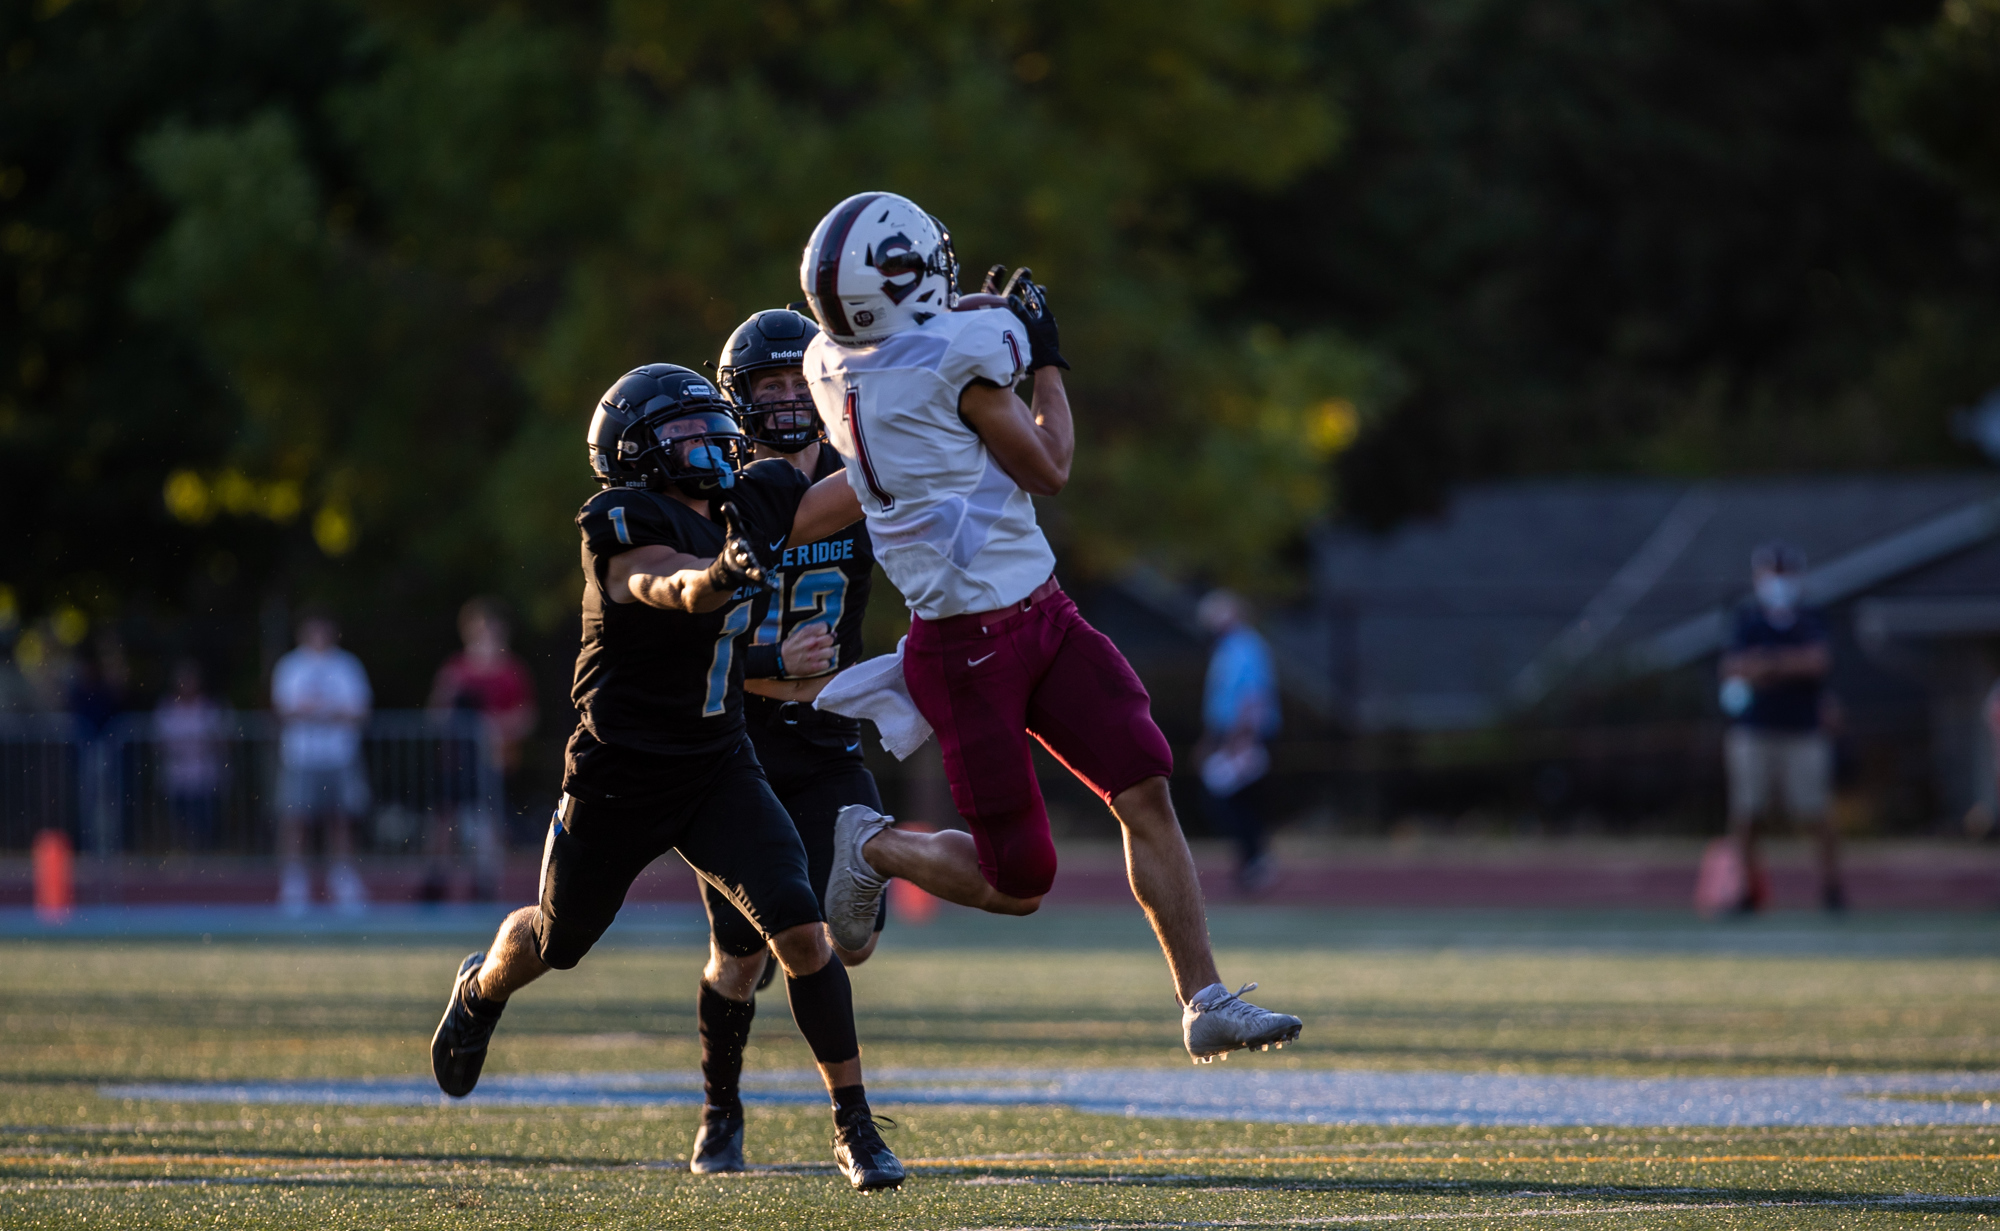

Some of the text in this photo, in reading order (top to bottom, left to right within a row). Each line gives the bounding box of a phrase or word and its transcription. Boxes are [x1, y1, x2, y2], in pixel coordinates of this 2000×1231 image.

[874, 232, 925, 305] S
[771, 350, 803, 359] Riddell
[1003, 329, 1024, 371] 1
[843, 386, 895, 513] 1
[607, 506, 633, 545] 1
[782, 539, 854, 567] ERIDGE
[753, 566, 850, 679] 12
[702, 599, 753, 717] 1
